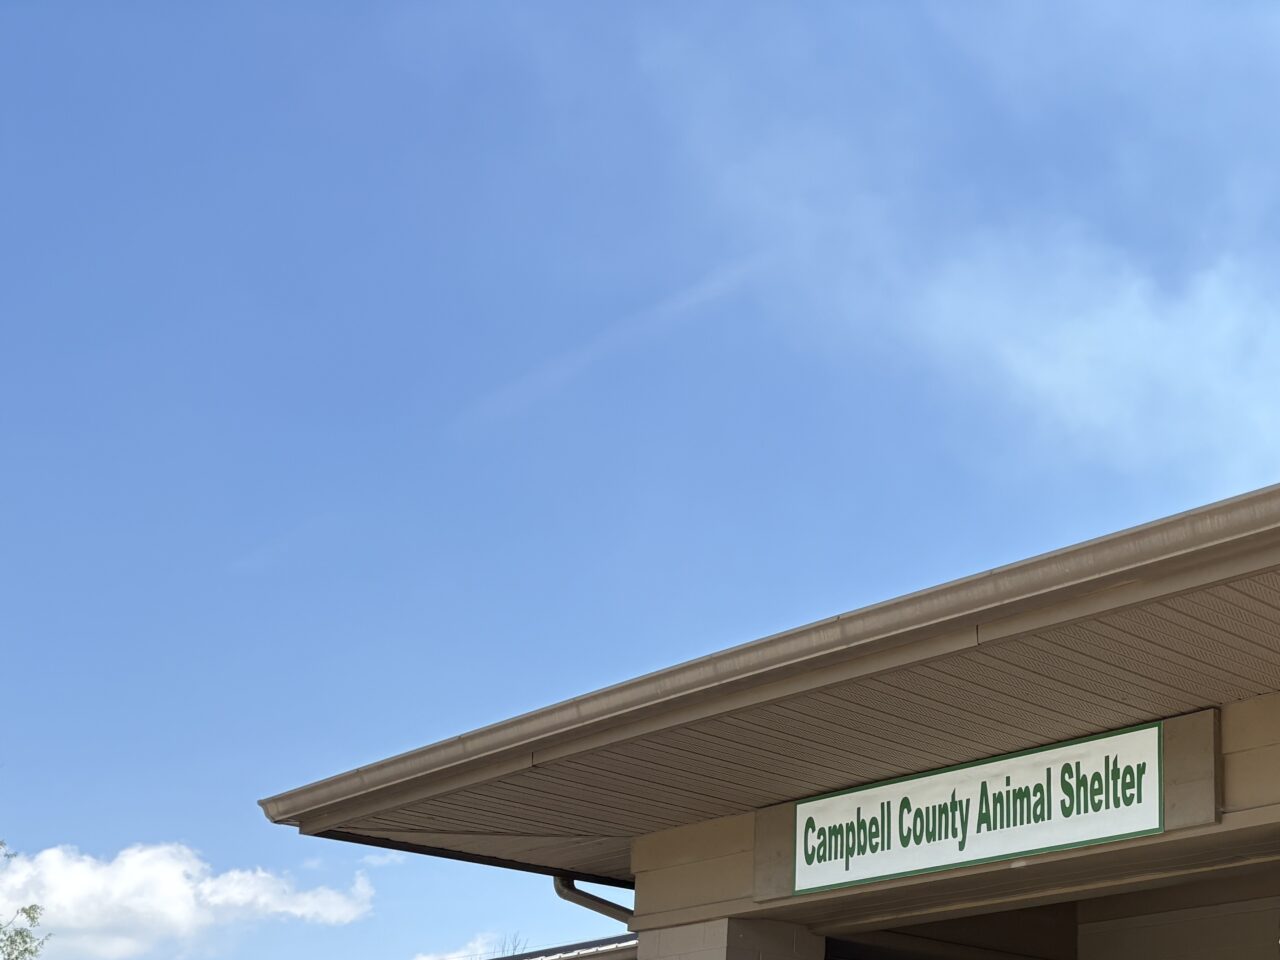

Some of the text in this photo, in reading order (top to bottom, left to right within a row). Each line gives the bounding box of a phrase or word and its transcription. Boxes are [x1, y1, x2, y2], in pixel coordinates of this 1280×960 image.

[803, 753, 1147, 871] Campbell County Animal Shelter
